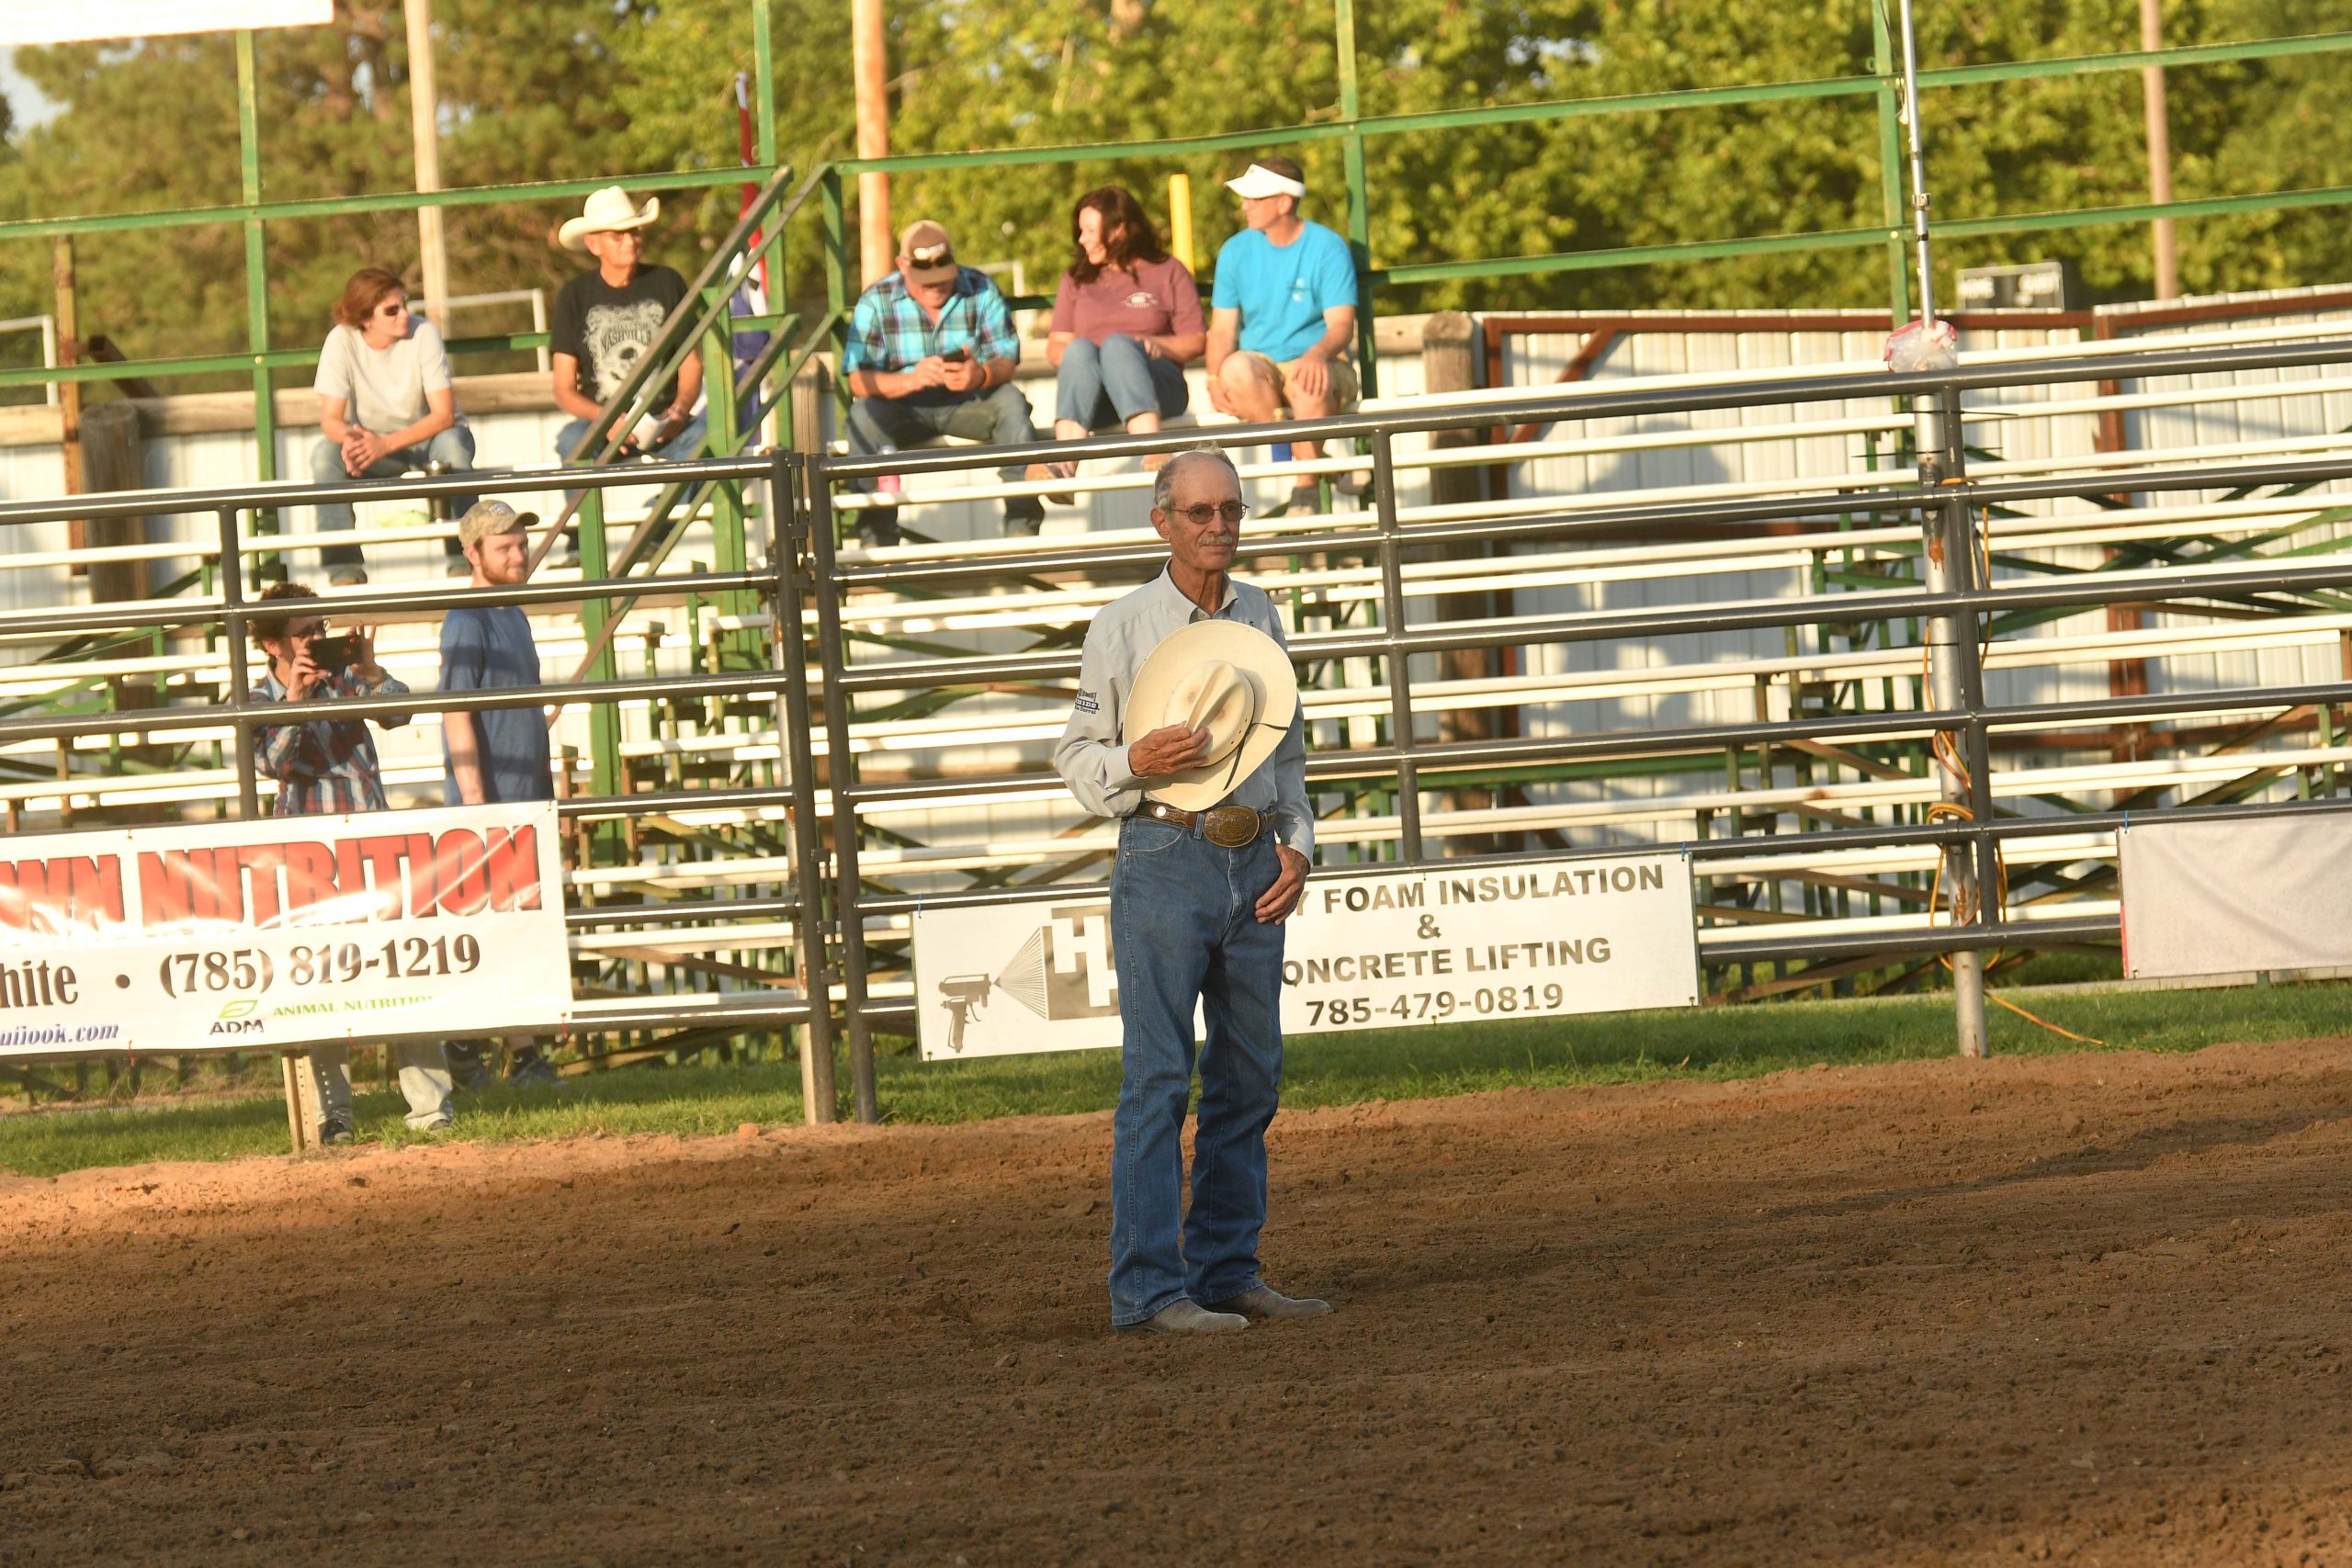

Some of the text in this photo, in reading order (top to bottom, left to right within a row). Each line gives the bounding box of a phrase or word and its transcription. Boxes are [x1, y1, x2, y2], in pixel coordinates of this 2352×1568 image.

[137, 824, 542, 936] NUTRITION
[1324, 882, 1425, 914] FOAM
[1439, 863, 1664, 905] INSULATION
[1417, 914, 1442, 940] &
[159, 947, 275, 999] (785)
[289, 933, 481, 987] 819-1219
[1465, 937, 1611, 973] LIFTING
[273, 1001, 337, 1017] ANIMAL
[1306, 983, 1564, 1026] 785-479-0819
[209, 1019, 265, 1036] ADM
